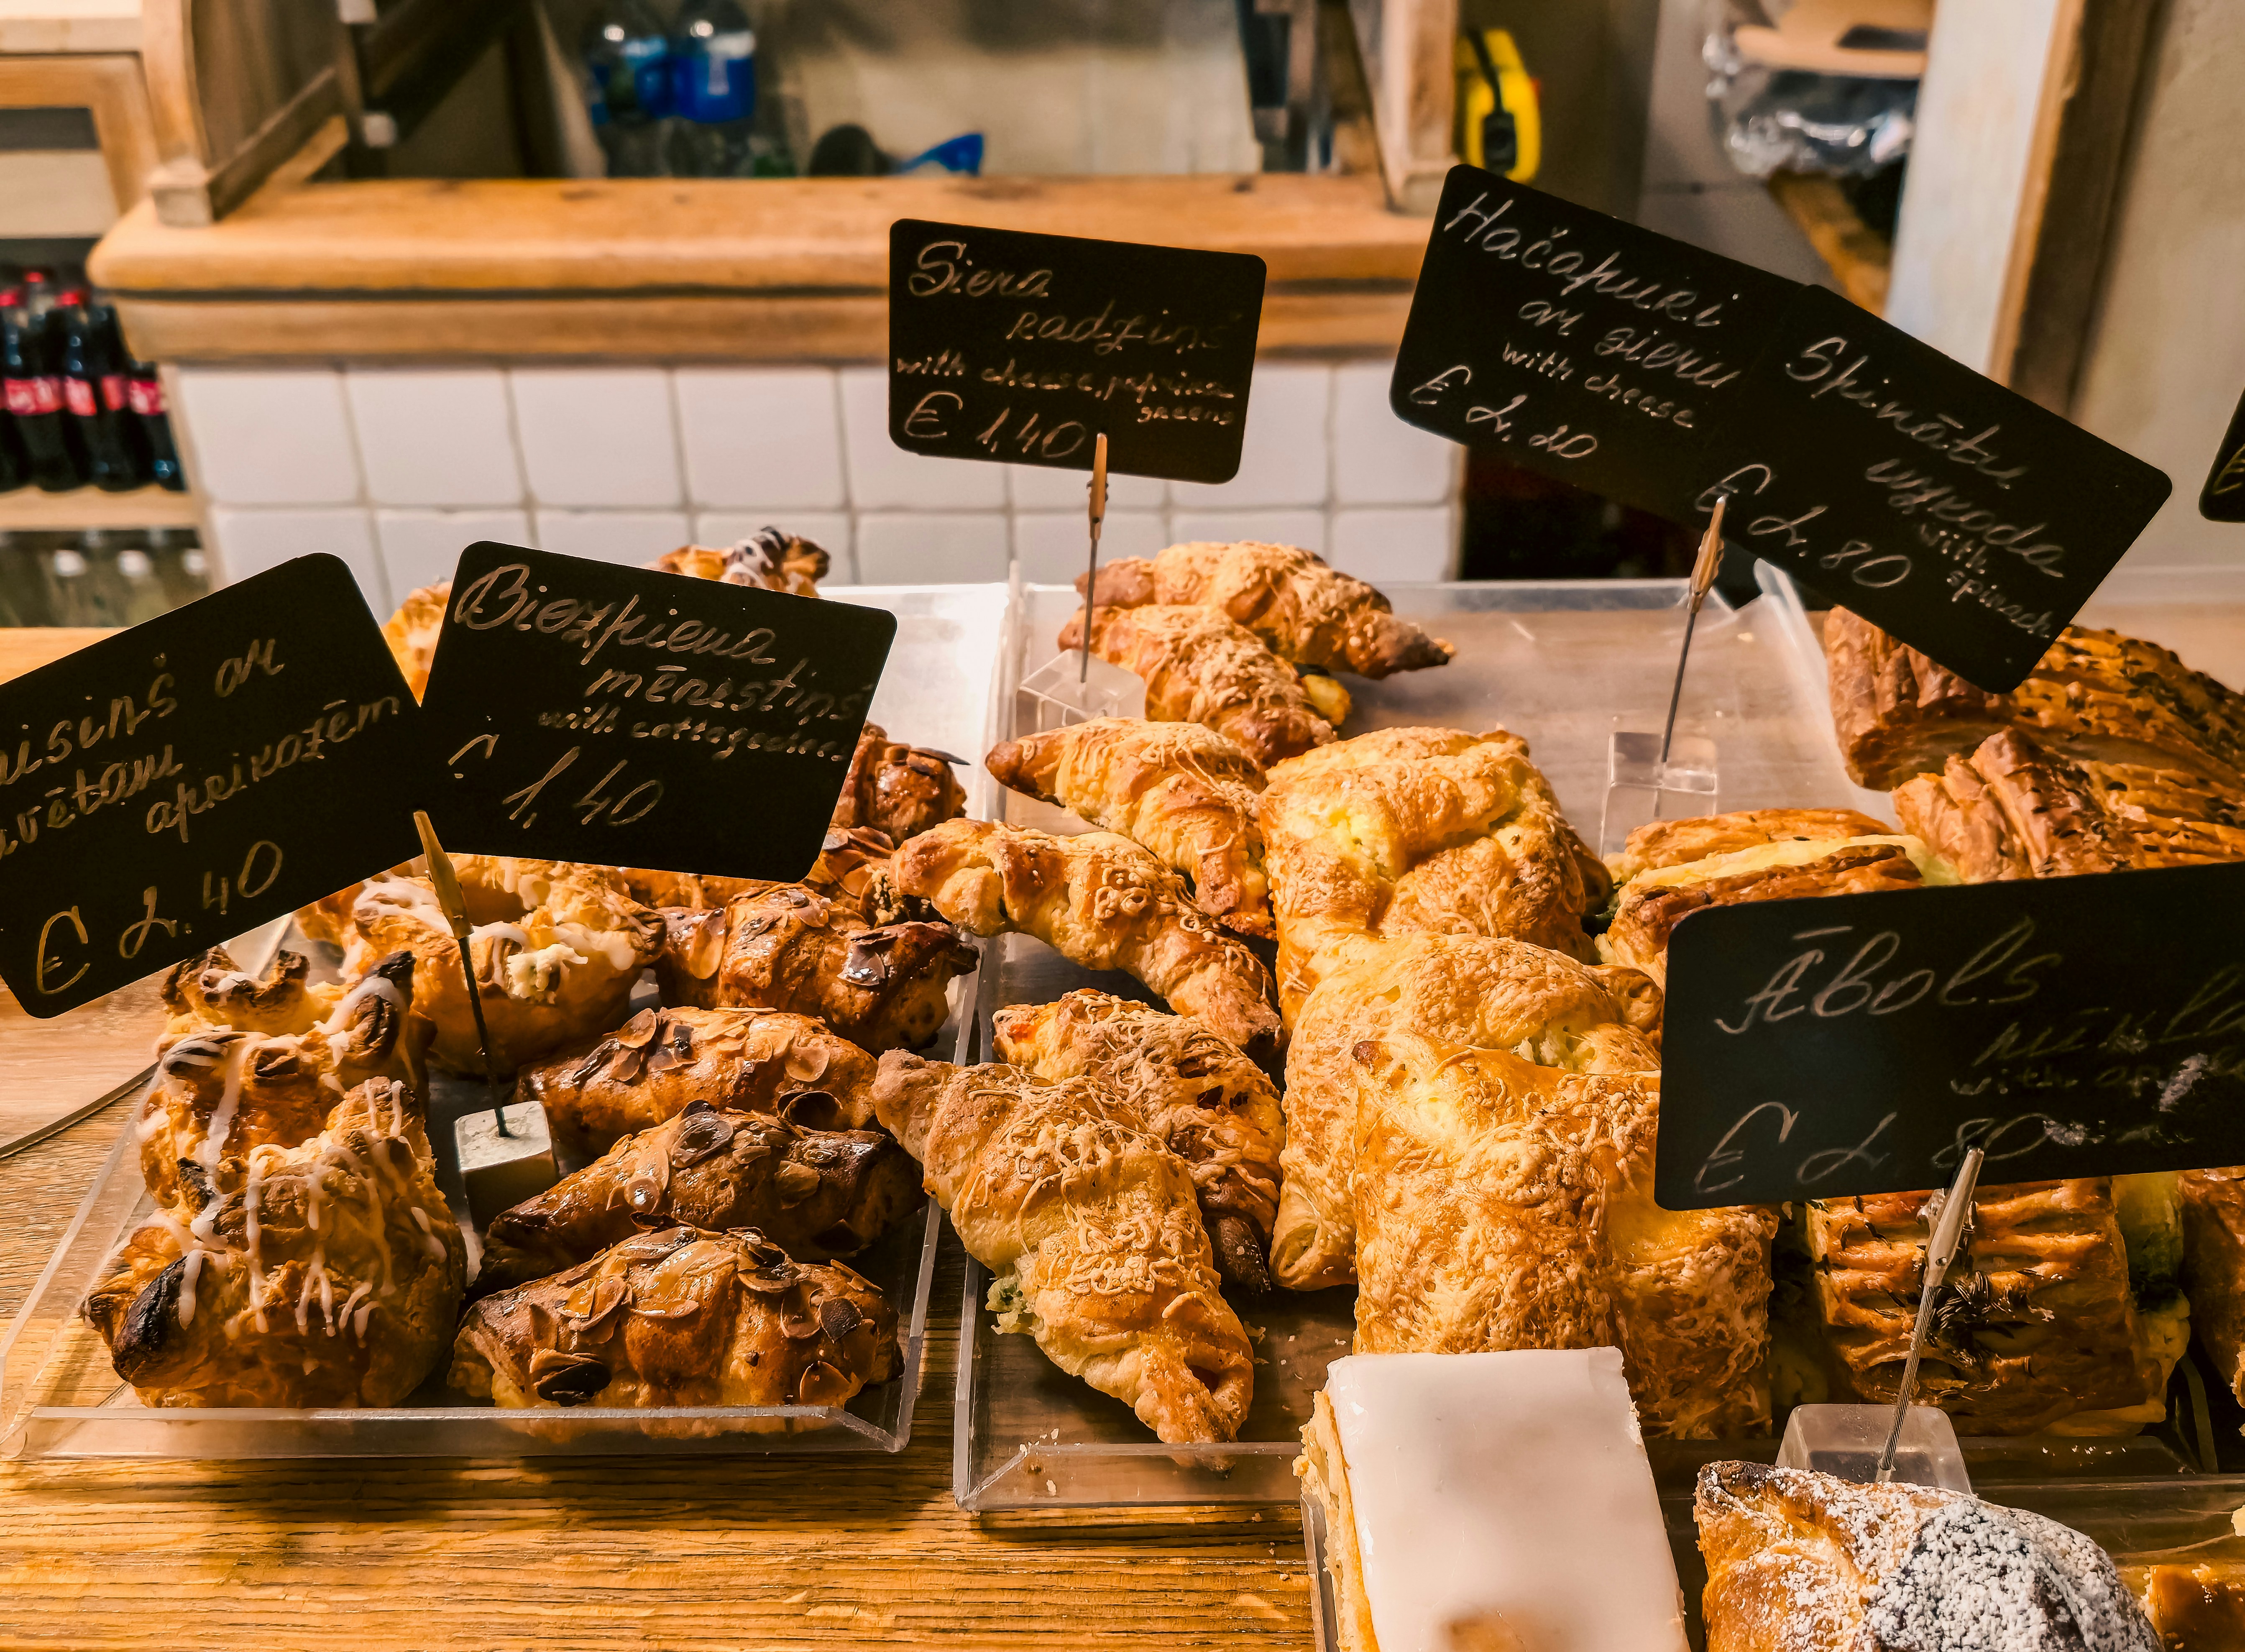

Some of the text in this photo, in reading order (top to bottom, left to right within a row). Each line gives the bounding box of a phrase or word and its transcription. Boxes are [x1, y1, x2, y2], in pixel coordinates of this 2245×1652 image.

[897, 349, 964, 377] with
[1502, 341, 1693, 428] with cheese
[538, 702, 621, 734] with
